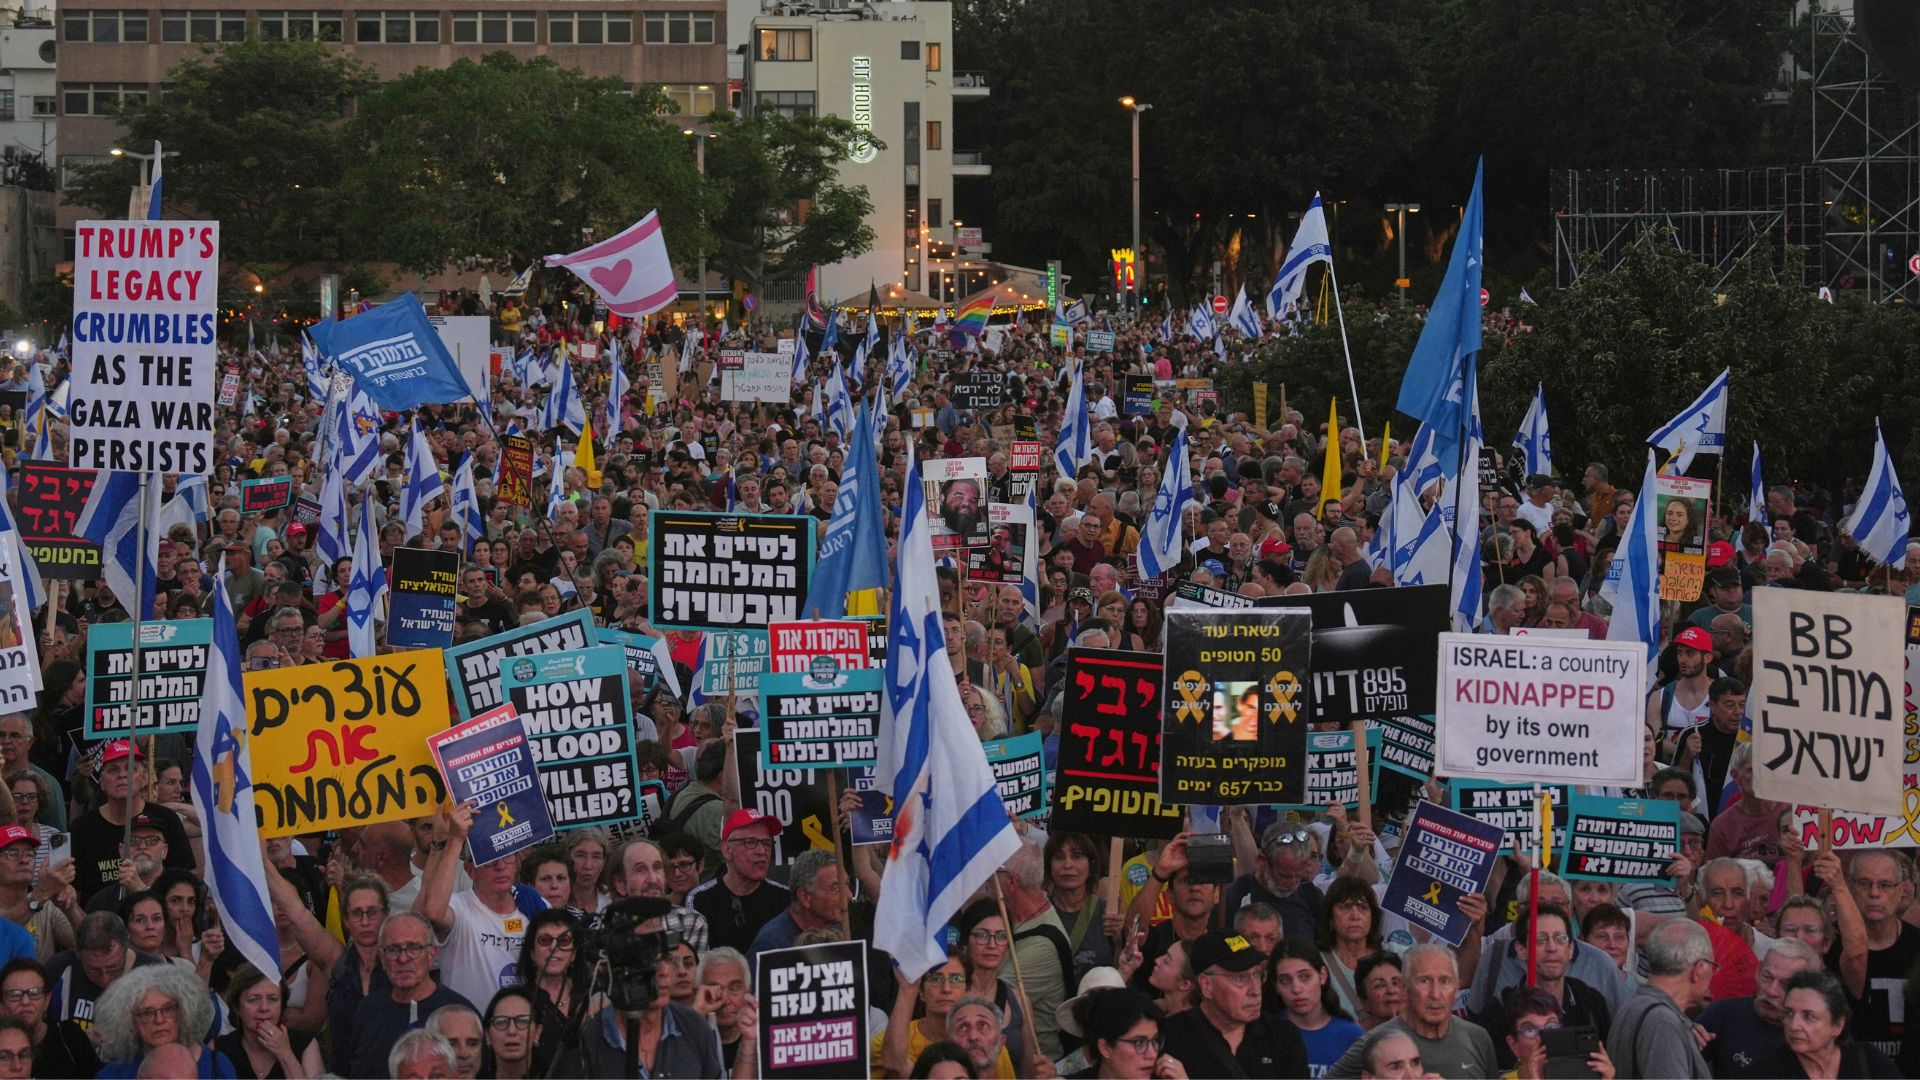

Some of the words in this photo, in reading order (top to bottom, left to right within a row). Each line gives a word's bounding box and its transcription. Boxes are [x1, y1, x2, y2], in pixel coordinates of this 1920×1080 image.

[853, 57, 870, 80] FIT
[853, 83, 870, 130] HOUSE
[79, 227, 214, 259] TRUMP'S
[90, 270, 203, 301] LEGACY
[73, 311, 214, 344] CRUMBLES
[90, 354, 126, 385] AS
[139, 355, 192, 387] THE
[970, 373, 1002, 383] טבח
[954, 384, 981, 394] ירפא
[987, 384, 1001, 394] לא
[969, 396, 1000, 407] טבח
[70, 398, 141, 429] GAZA
[150, 401, 213, 431] WAR
[73, 438, 207, 473] PERSISTS
[22, 506, 76, 533] וגד
[663, 533, 707, 557] את
[713, 534, 797, 561] לסיים
[969, 561, 980, 569] HIM
[970, 553, 985, 562] BRING
[431, 570, 456, 583] עתיד
[663, 560, 797, 588] המלחמה
[1671, 562, 1703, 575] האישה
[400, 580, 455, 594] הקואליציה
[443, 599, 454, 609] או
[662, 587, 797, 625] עכשיו!
[400, 617, 435, 630] ישראל
[420, 609, 454, 620] העתיד
[436, 620, 453, 632] של
[1202, 625, 1229, 639] עוד
[1234, 624, 1280, 638] נשארו
[1790, 611, 1853, 660] BB
[512, 625, 585, 656] עצרו
[715, 634, 749, 657] YES
[753, 636, 766, 654] to
[778, 629, 802, 650] את
[805, 628, 860, 652] הפקרת
[145, 645, 205, 671] לסיים
[1200, 650, 1256, 662] חטופים
[1261, 648, 1282, 661] 50
[1453, 646, 1537, 670] ISRAEL:
[1541, 655, 1552, 670] a
[1559, 654, 1629, 679] country
[462, 649, 507, 681] את
[711, 663, 718, 675] a
[525, 678, 602, 709] HOW
[711, 675, 759, 692] allance
[1076, 670, 1163, 717] יבי
[1173, 681, 1211, 691] מצפים
[1264, 682, 1302, 693] מצפים
[1313, 669, 1358, 716] די!
[1363, 666, 1407, 696] 895
[1762, 659, 1892, 721] מחריב
[251, 662, 421, 736] עוצרים
[816, 692, 879, 714] לסיים
[1364, 695, 1409, 713] נופלים
[1455, 678, 1615, 711] KIDNAPPED
[159, 702, 198, 730] מען
[779, 697, 812, 716] את
[521, 702, 613, 735] MUCH
[783, 717, 872, 739] המלחמה
[1486, 714, 1510, 739] by
[1517, 716, 1541, 736] its
[1547, 721, 1589, 738] own
[495, 735, 522, 749] עוצרים
[1382, 724, 1401, 741] THE
[289, 724, 379, 774] את
[482, 745, 495, 755] את
[529, 730, 621, 763] BLOOD
[771, 741, 830, 762] כולנו!
[833, 740, 874, 765] מען
[1761, 709, 1884, 782] ישראל
[449, 750, 482, 768] המלחמה
[460, 750, 519, 780] מחזירים
[1176, 755, 1217, 769] בעזה
[1222, 756, 1287, 771] מופקרים
[1476, 745, 1599, 767] government
[494, 768, 516, 782] את
[593, 762, 628, 790] BE
[993, 755, 1039, 778] הממשל
[472, 776, 490, 793] כל
[1020, 773, 1039, 790] על
[1177, 779, 1211, 791] ימים
[1219, 780, 1250, 796] 657
[1253, 781, 1283, 791] כבר
[1308, 770, 1358, 787] מלחמ
[253, 754, 447, 829] המלחמה
[1472, 790, 1502, 807] את
[1506, 787, 1560, 807] ליים
[549, 788, 631, 822] ILLED?
[756, 789, 793, 827] DO
[1418, 818, 1453, 836] המלחמה
[1453, 830, 1465, 840] את
[1576, 818, 1617, 835] ויתרה
[1618, 821, 1675, 839] הממשלה
[1801, 816, 1886, 848] NOW
[1421, 831, 1481, 862] מחזירים
[1467, 835, 1494, 850] עוצרים
[1573, 836, 1650, 857] החטופים
[1653, 841, 1674, 859] על
[98, 859, 122, 871] WAKE
[1421, 846, 1442, 864] כל
[1580, 856, 1611, 873] לא!
[101, 871, 121, 882] BAS
[1408, 857, 1474, 890] החטופים
[1450, 860, 1470, 874] את
[1613, 859, 1662, 876] אנחנו
[770, 960, 854, 992] מצילים
[771, 991, 816, 1017] עזה
[821, 987, 855, 1012] את
[773, 1027, 797, 1044] את
[800, 1021, 853, 1041] מצילים
[773, 1039, 854, 1065] החטופים
